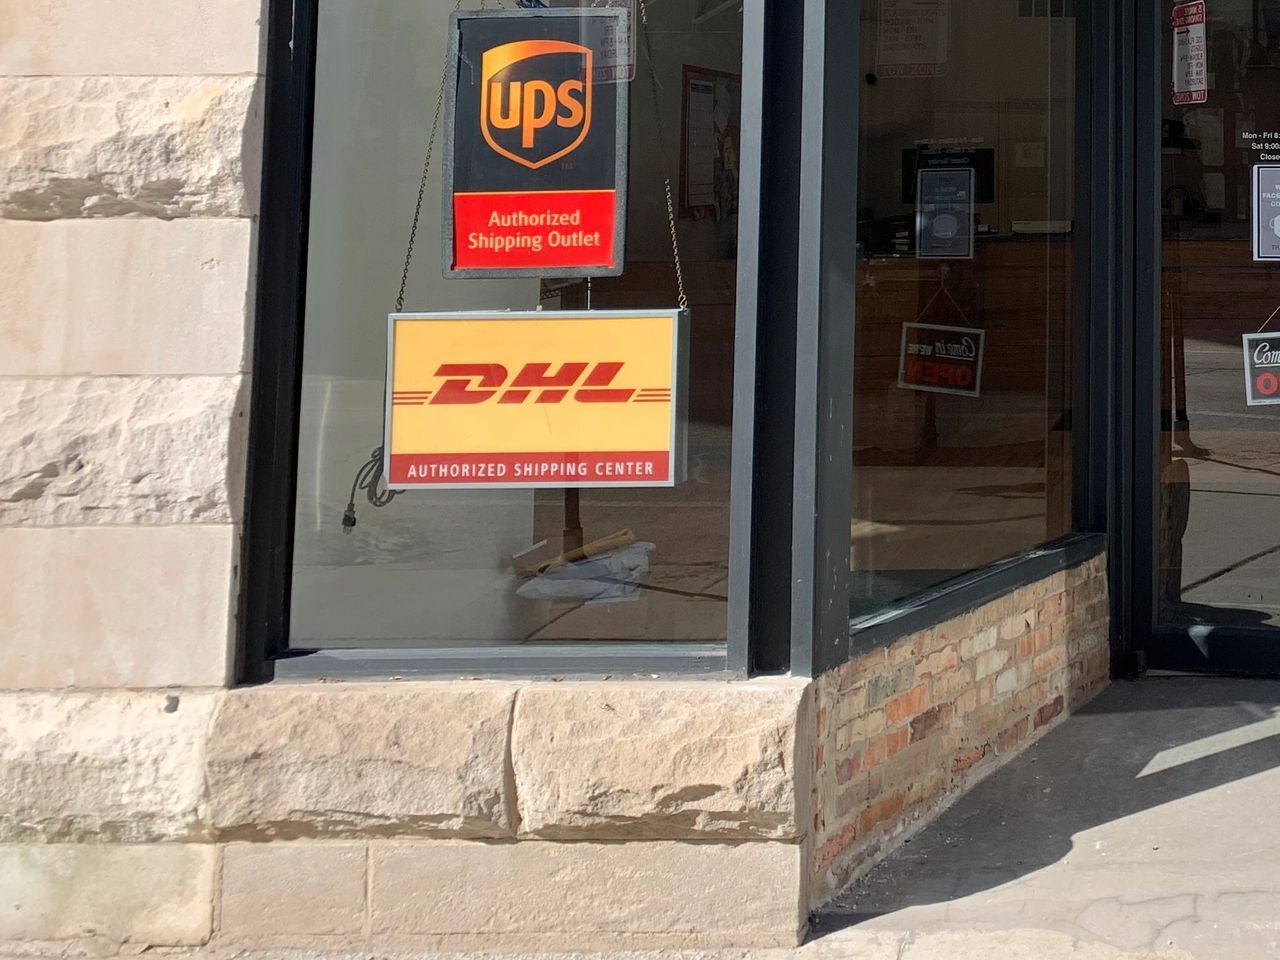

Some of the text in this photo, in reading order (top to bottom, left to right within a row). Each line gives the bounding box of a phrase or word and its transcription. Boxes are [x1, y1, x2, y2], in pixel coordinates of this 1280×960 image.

[489, 79, 586, 149] ups
[1242, 131, 1257, 139] Mon
[1263, 131, 1273, 139] Fri
[1251, 142, 1263, 150] Sat
[488, 210, 581, 227] Authorized
[468, 231, 600, 252] Shipping Outlet
[428, 361, 637, 405] DHL
[407, 461, 654, 478] AUTHORIZED SHIPPING CENTER
